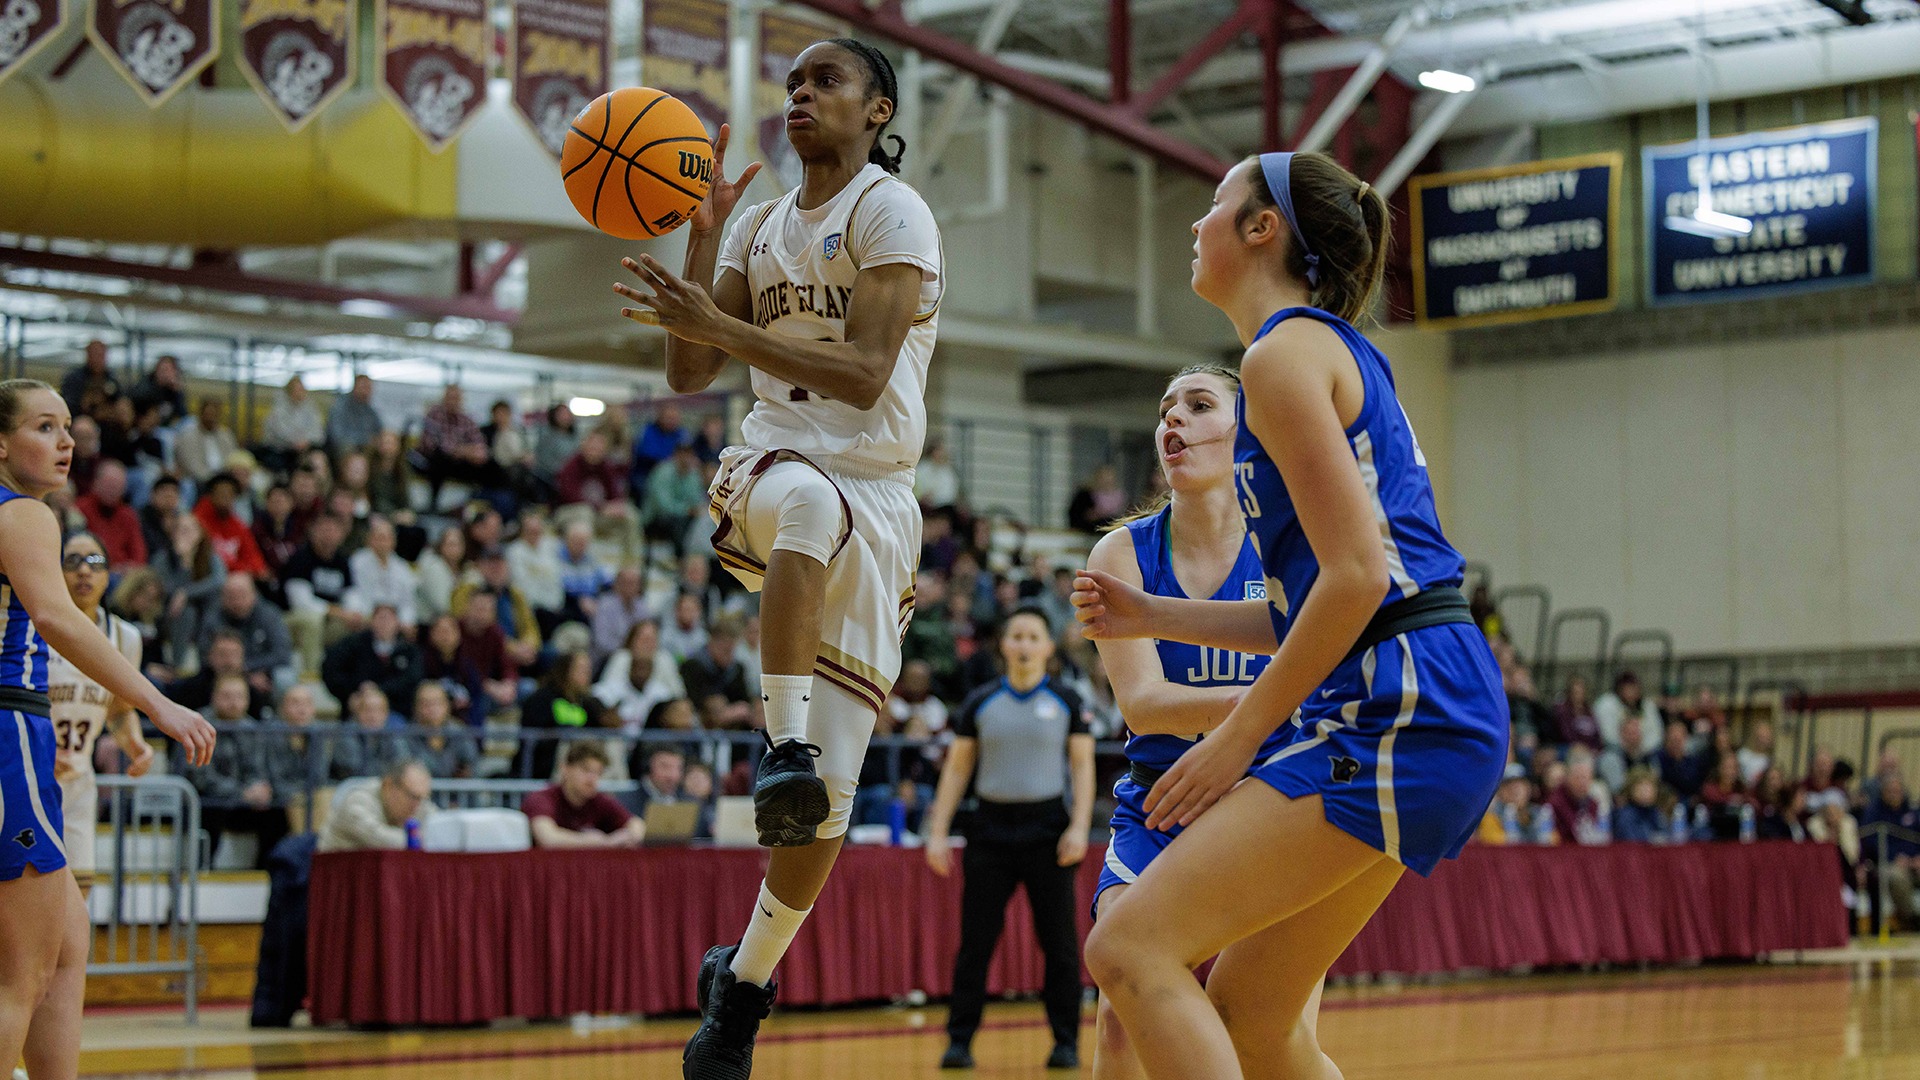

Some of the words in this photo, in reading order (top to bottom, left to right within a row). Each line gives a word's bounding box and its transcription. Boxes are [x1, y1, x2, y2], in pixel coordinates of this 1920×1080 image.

[1688, 140, 1830, 187] EASTERN
[1448, 170, 1579, 213] UNIVERSITY
[1666, 172, 1853, 217] CONECTICUT
[826, 239, 838, 251] 50
[1673, 243, 1846, 291] UNIVERSITY
[1251, 588, 1266, 599] 50
[1187, 645, 1258, 682] JOE
[56, 720, 90, 751] 33
